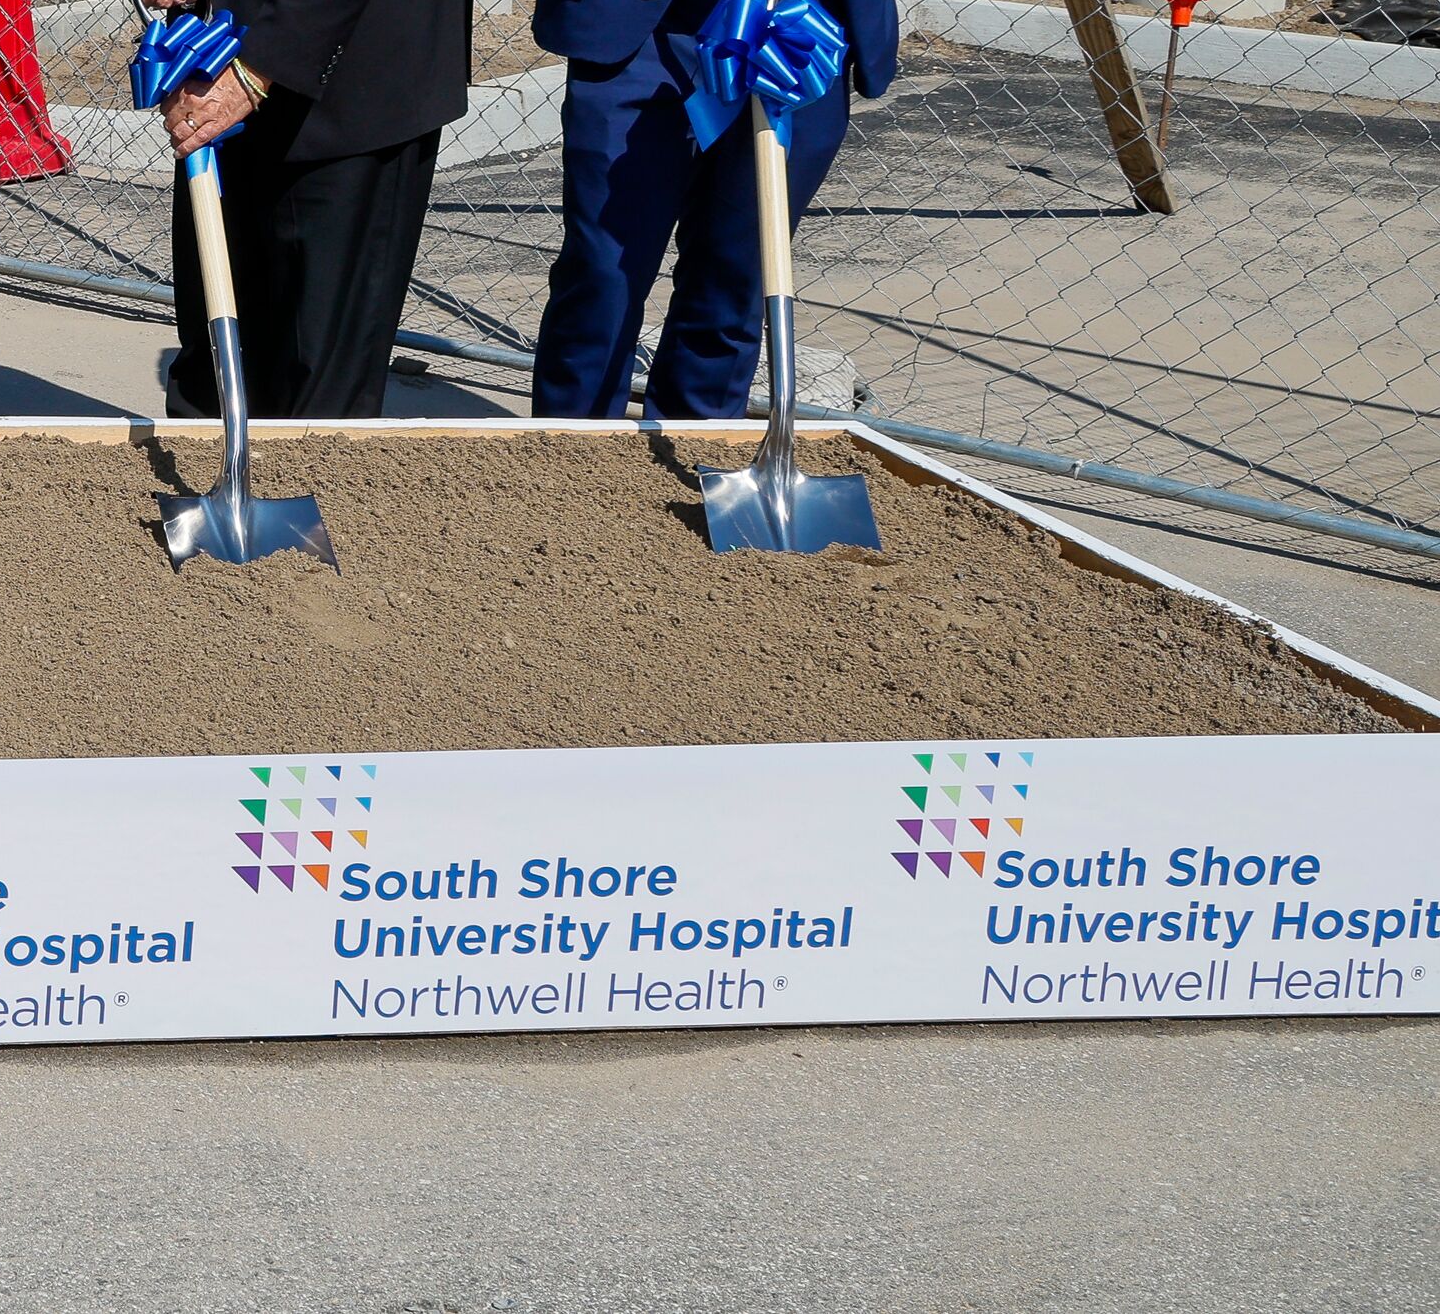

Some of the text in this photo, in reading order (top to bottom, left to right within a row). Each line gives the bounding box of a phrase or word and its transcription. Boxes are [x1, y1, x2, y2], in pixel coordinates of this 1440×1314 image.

[339, 857, 677, 901] South Shore
[993, 846, 1320, 888] South Shore
[334, 907, 853, 961] University Hospital
[987, 899, 1440, 949] University Hospit
[332, 973, 586, 1019] Northwell
[982, 960, 1228, 1004] Northwell
